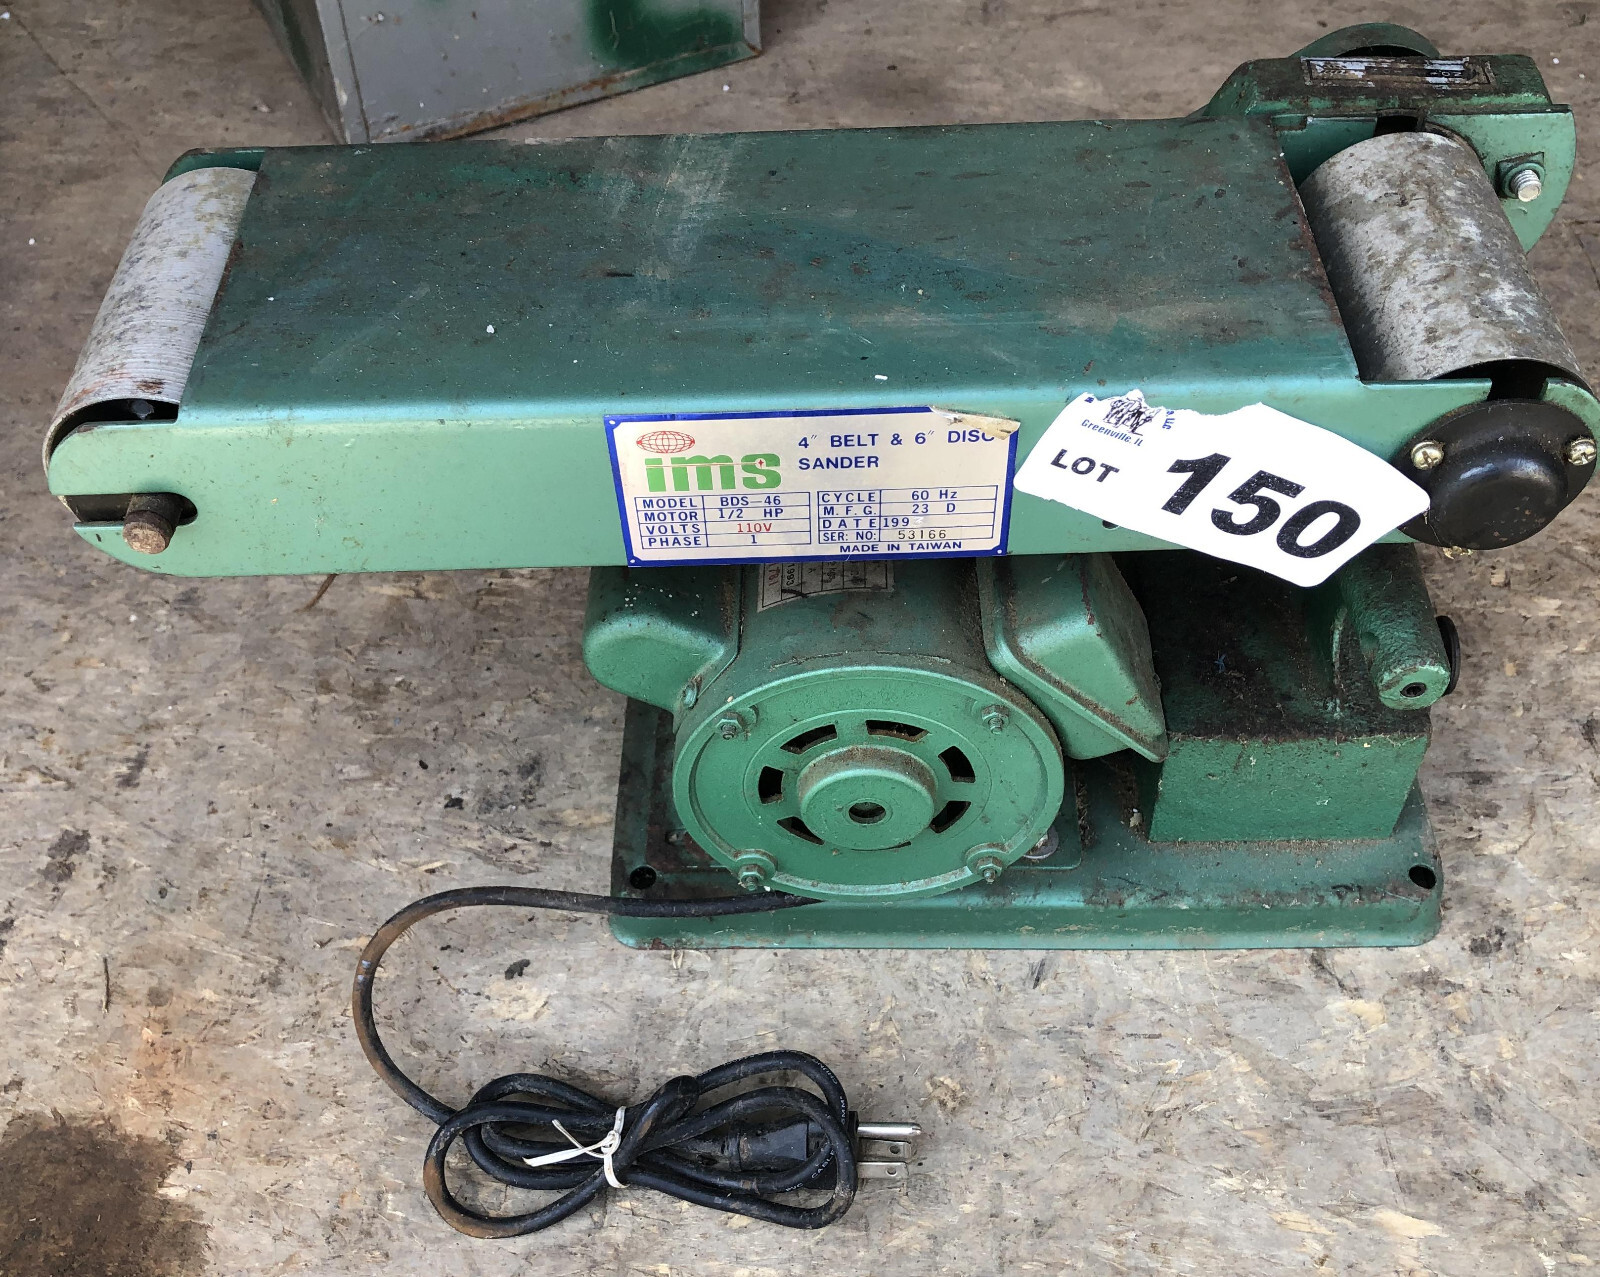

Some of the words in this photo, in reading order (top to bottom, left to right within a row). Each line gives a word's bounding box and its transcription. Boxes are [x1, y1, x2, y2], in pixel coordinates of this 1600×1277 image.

[830, 433, 879, 448] BELT
[890, 433, 903, 446] &
[798, 455, 879, 470] SANDER
[1050, 448, 1120, 483] LOT
[645, 453, 782, 492] ims
[821, 491, 876, 503] CYCLE
[911, 490, 930, 501] 60
[939, 489, 958, 500] Hz
[642, 497, 698, 509] MODEL
[911, 503, 930, 514] 23
[946, 503, 956, 513] D
[1161, 452, 1361, 559] 150
[644, 511, 699, 522] MOTOR
[718, 509, 744, 519] 1/2
[763, 508, 784, 518] HP
[645, 523, 701, 535] VOLTS
[737, 522, 773, 533] 110V
[822, 518, 877, 529] DATE
[648, 536, 702, 547] PHASE
[751, 535, 758, 544] 1
[898, 530, 947, 540] 53166
[839, 543, 879, 553] MADE
[887, 543, 900, 552] IN
[909, 541, 962, 551] TAIWAN
